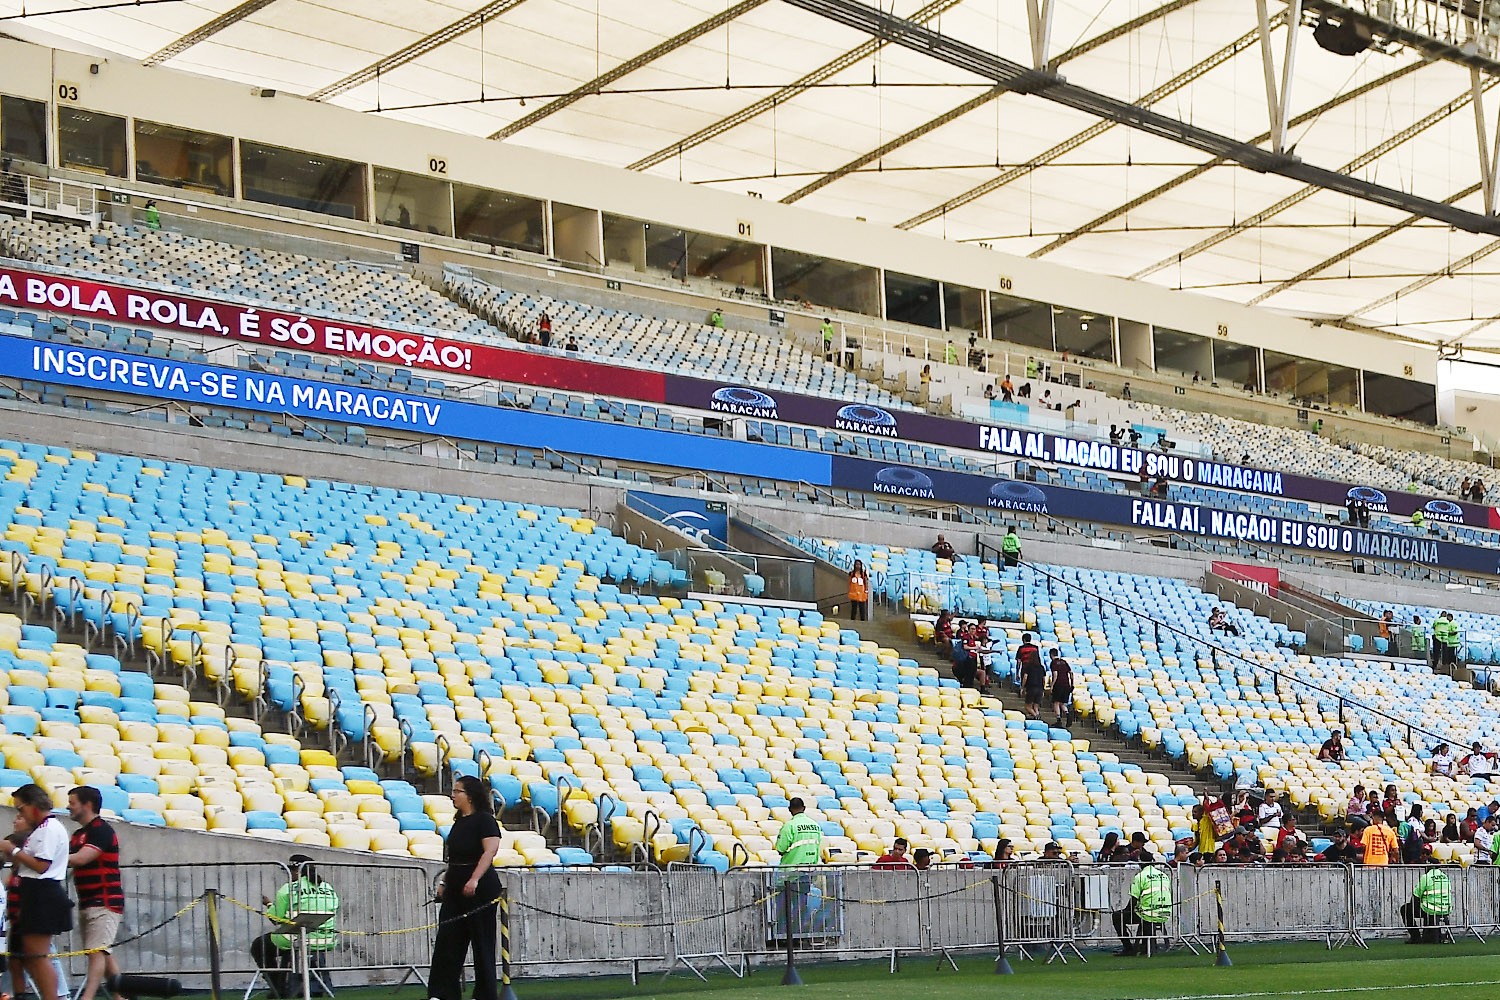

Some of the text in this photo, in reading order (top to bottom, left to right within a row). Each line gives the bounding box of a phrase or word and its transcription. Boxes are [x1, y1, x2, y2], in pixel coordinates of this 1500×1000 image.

[58, 84, 78, 100] 03
[429, 158, 446, 173] 02
[738, 222, 751, 236] 01
[1000, 277, 1012, 289] 60
[0, 274, 472, 371] A BOLA ROLA, É SÓ EMOÇÃO!
[1217, 325, 1228, 337] 59
[1404, 365, 1413, 376] 58
[33, 346, 441, 426] INSCREVA-SE NA MARACATV
[979, 426, 1283, 495] FALA AÍ, NAÇÃO! EU SOU O MARACANÃ
[1132, 500, 1439, 564] FALA AÍ, NAÇÃO! EU SOU O MARACANÃ
